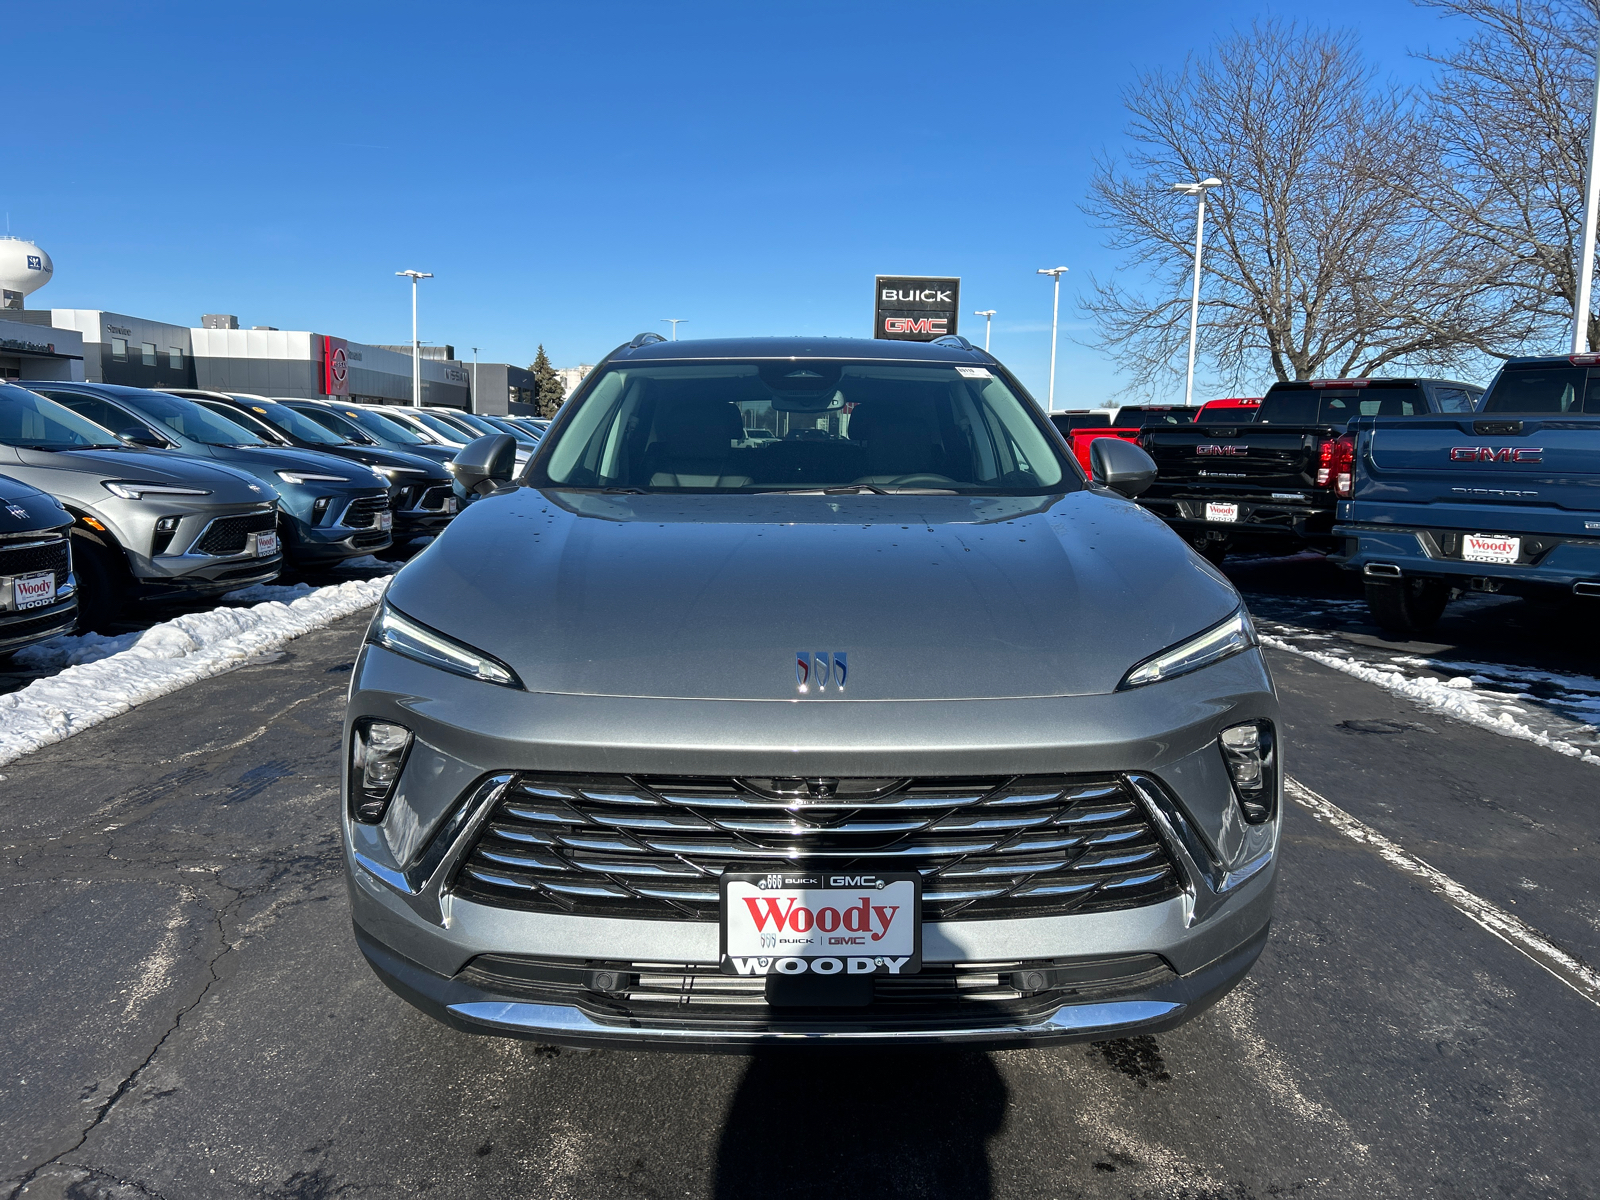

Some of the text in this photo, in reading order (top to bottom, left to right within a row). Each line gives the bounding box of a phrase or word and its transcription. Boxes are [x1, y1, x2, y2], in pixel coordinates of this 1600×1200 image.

[882, 289, 952, 302] BUICK
[885, 317, 948, 333] GMC
[1196, 445, 1248, 456] GMC
[1450, 446, 1543, 463] GMC
[1209, 505, 1235, 517] Woody
[1469, 539, 1515, 554] Woody
[17, 580, 51, 595] Woody
[18, 597, 56, 610] WOODY
[830, 876, 876, 886] GMC
[742, 897, 900, 942] Woody
[828, 937, 865, 945] GMC
[731, 957, 910, 975] WOODY
